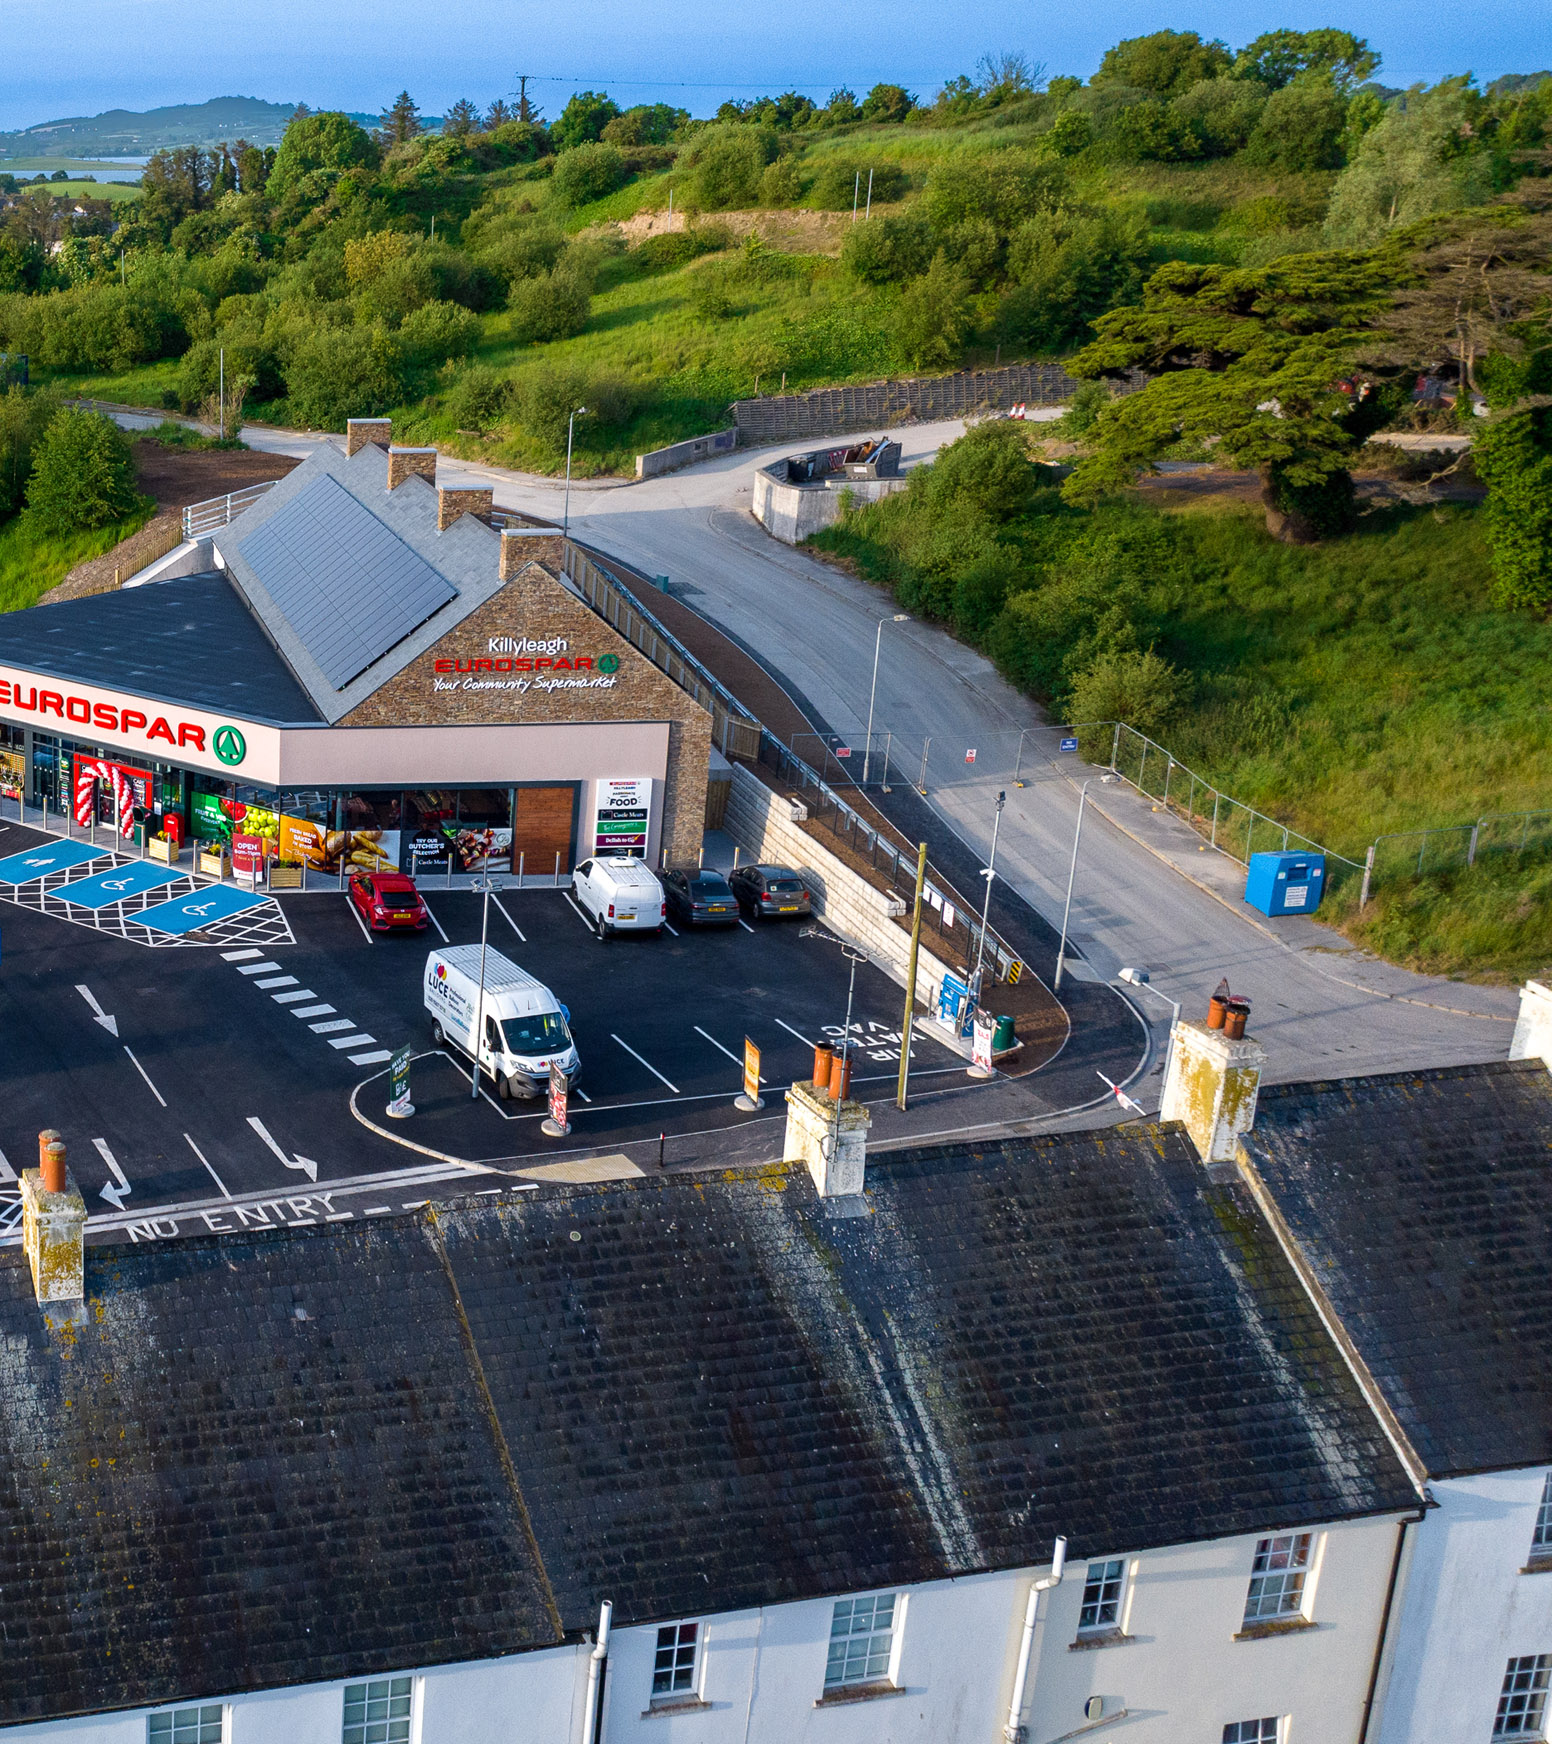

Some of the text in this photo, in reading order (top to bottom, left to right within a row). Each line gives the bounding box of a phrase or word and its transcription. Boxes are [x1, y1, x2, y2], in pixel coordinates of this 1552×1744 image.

[488, 637, 568, 655] Killyleagh
[435, 657, 593, 673] EUROSPAR
[433, 675, 617, 694] Your Community Supermarket
[609, 798, 638, 806] FOOD
[237, 842, 257, 851] OPEN
[428, 972, 449, 998] LUCE
[821, 1021, 890, 1036] VAC
[200, 1192, 336, 1233] ENTRY
[125, 1217, 179, 1243] NO
